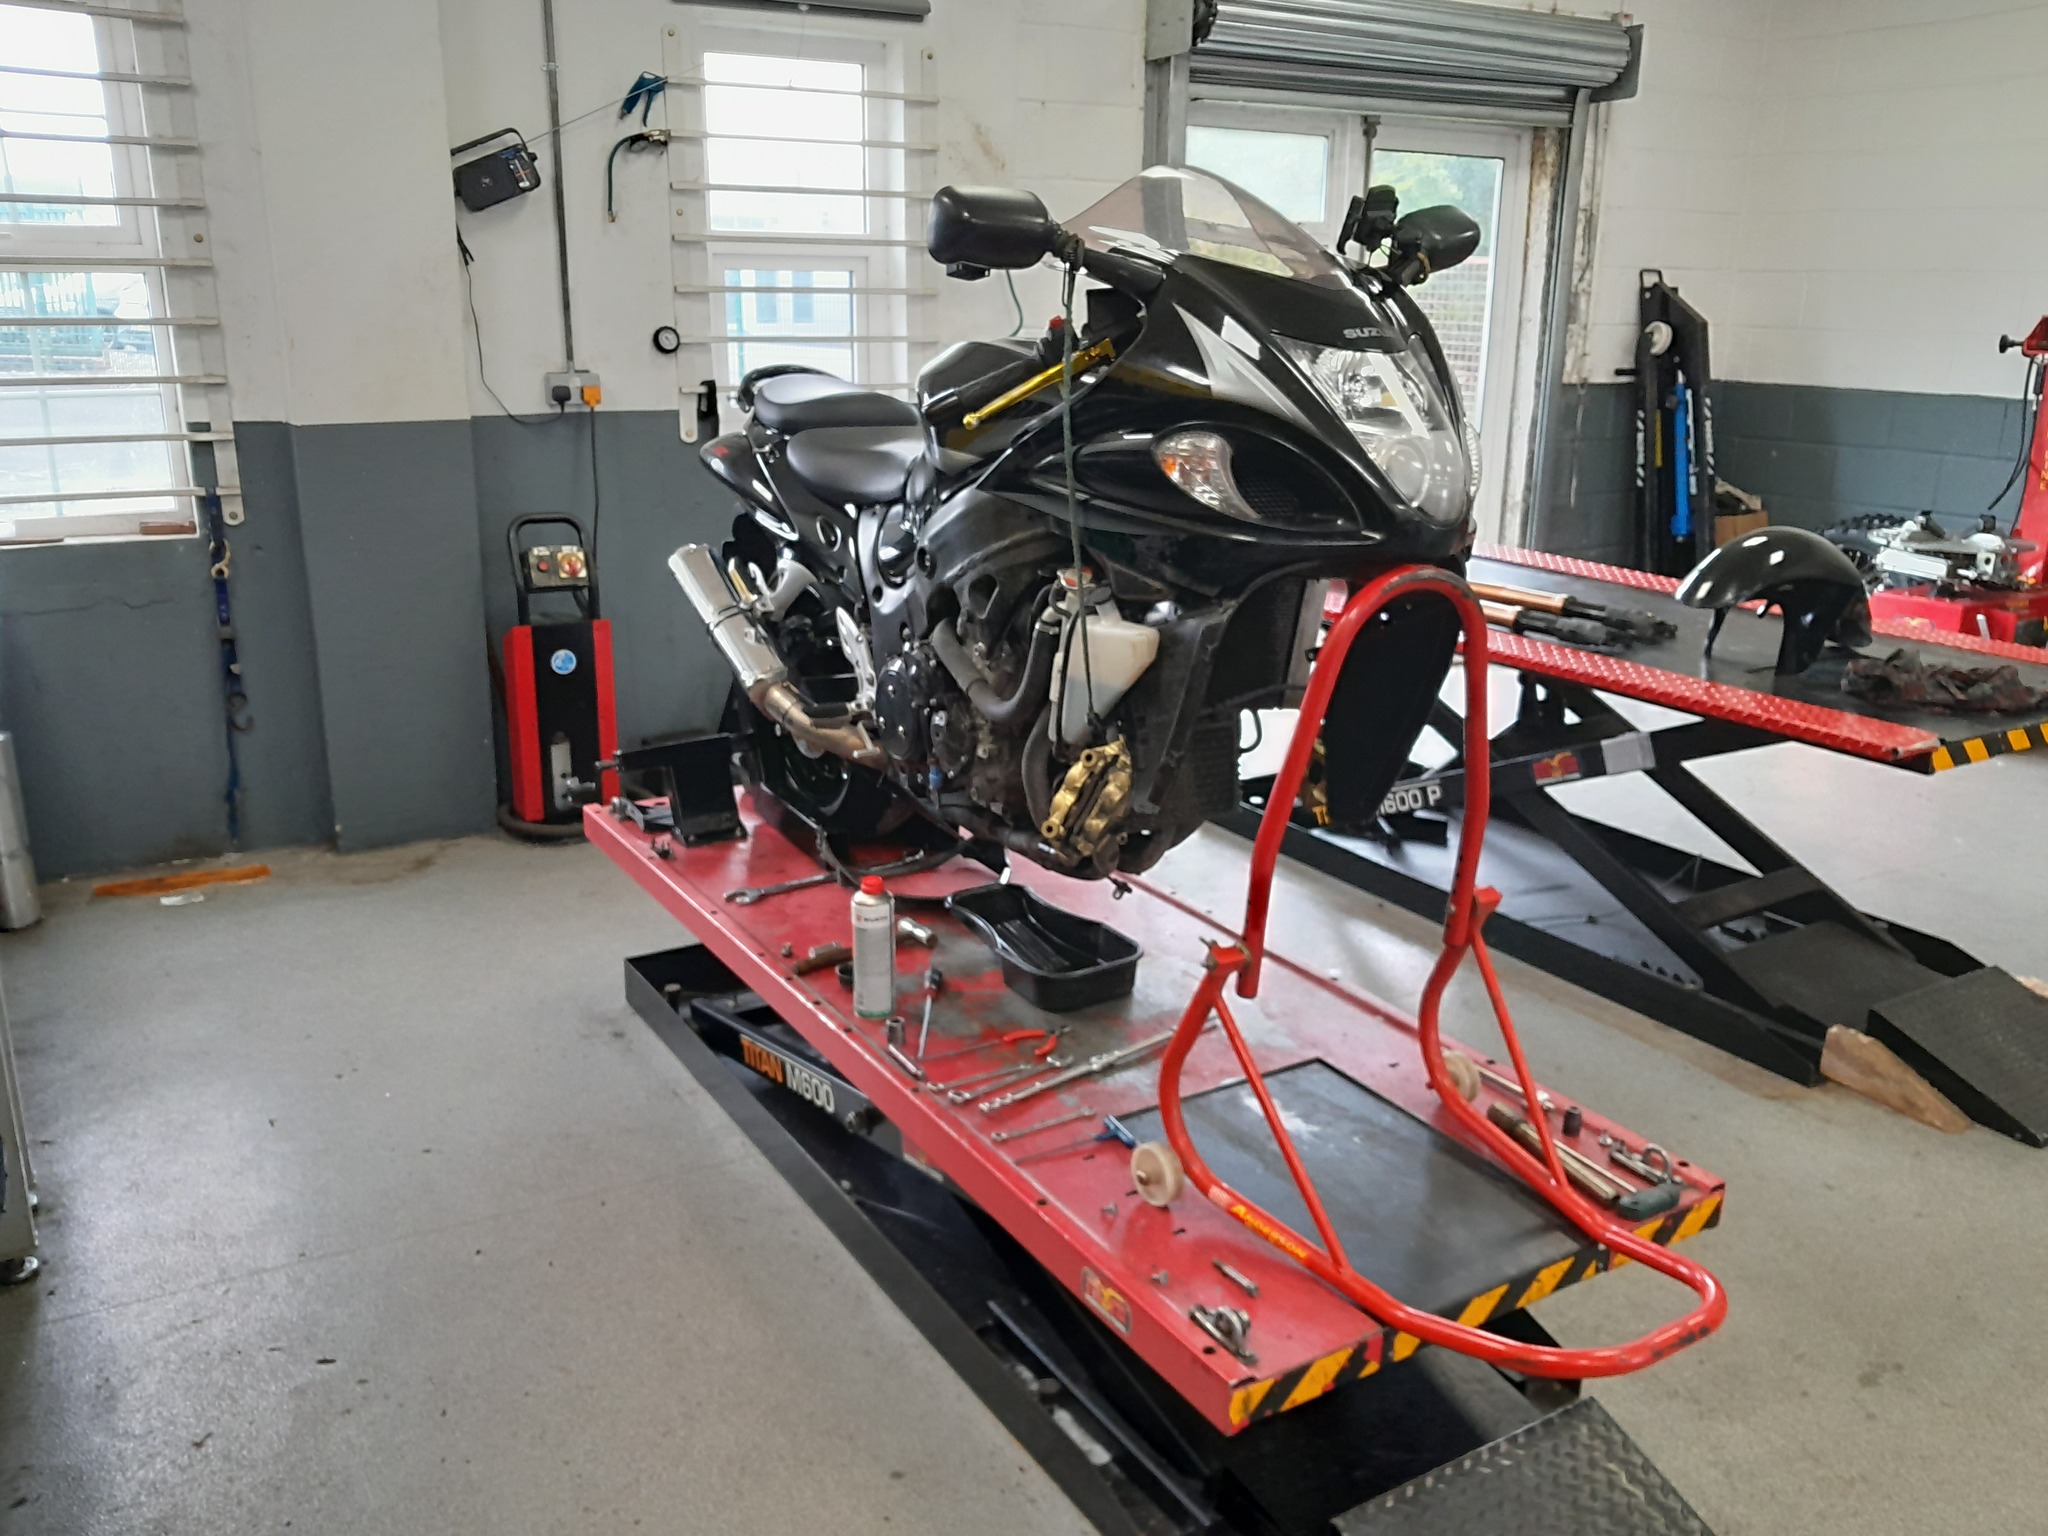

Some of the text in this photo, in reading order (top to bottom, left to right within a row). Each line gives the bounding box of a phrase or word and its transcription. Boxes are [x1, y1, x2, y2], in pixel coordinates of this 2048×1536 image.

[1343, 327, 1387, 339] SUZ
[1427, 785, 1441, 806] P
[740, 1037, 835, 1114] TITAN M600
